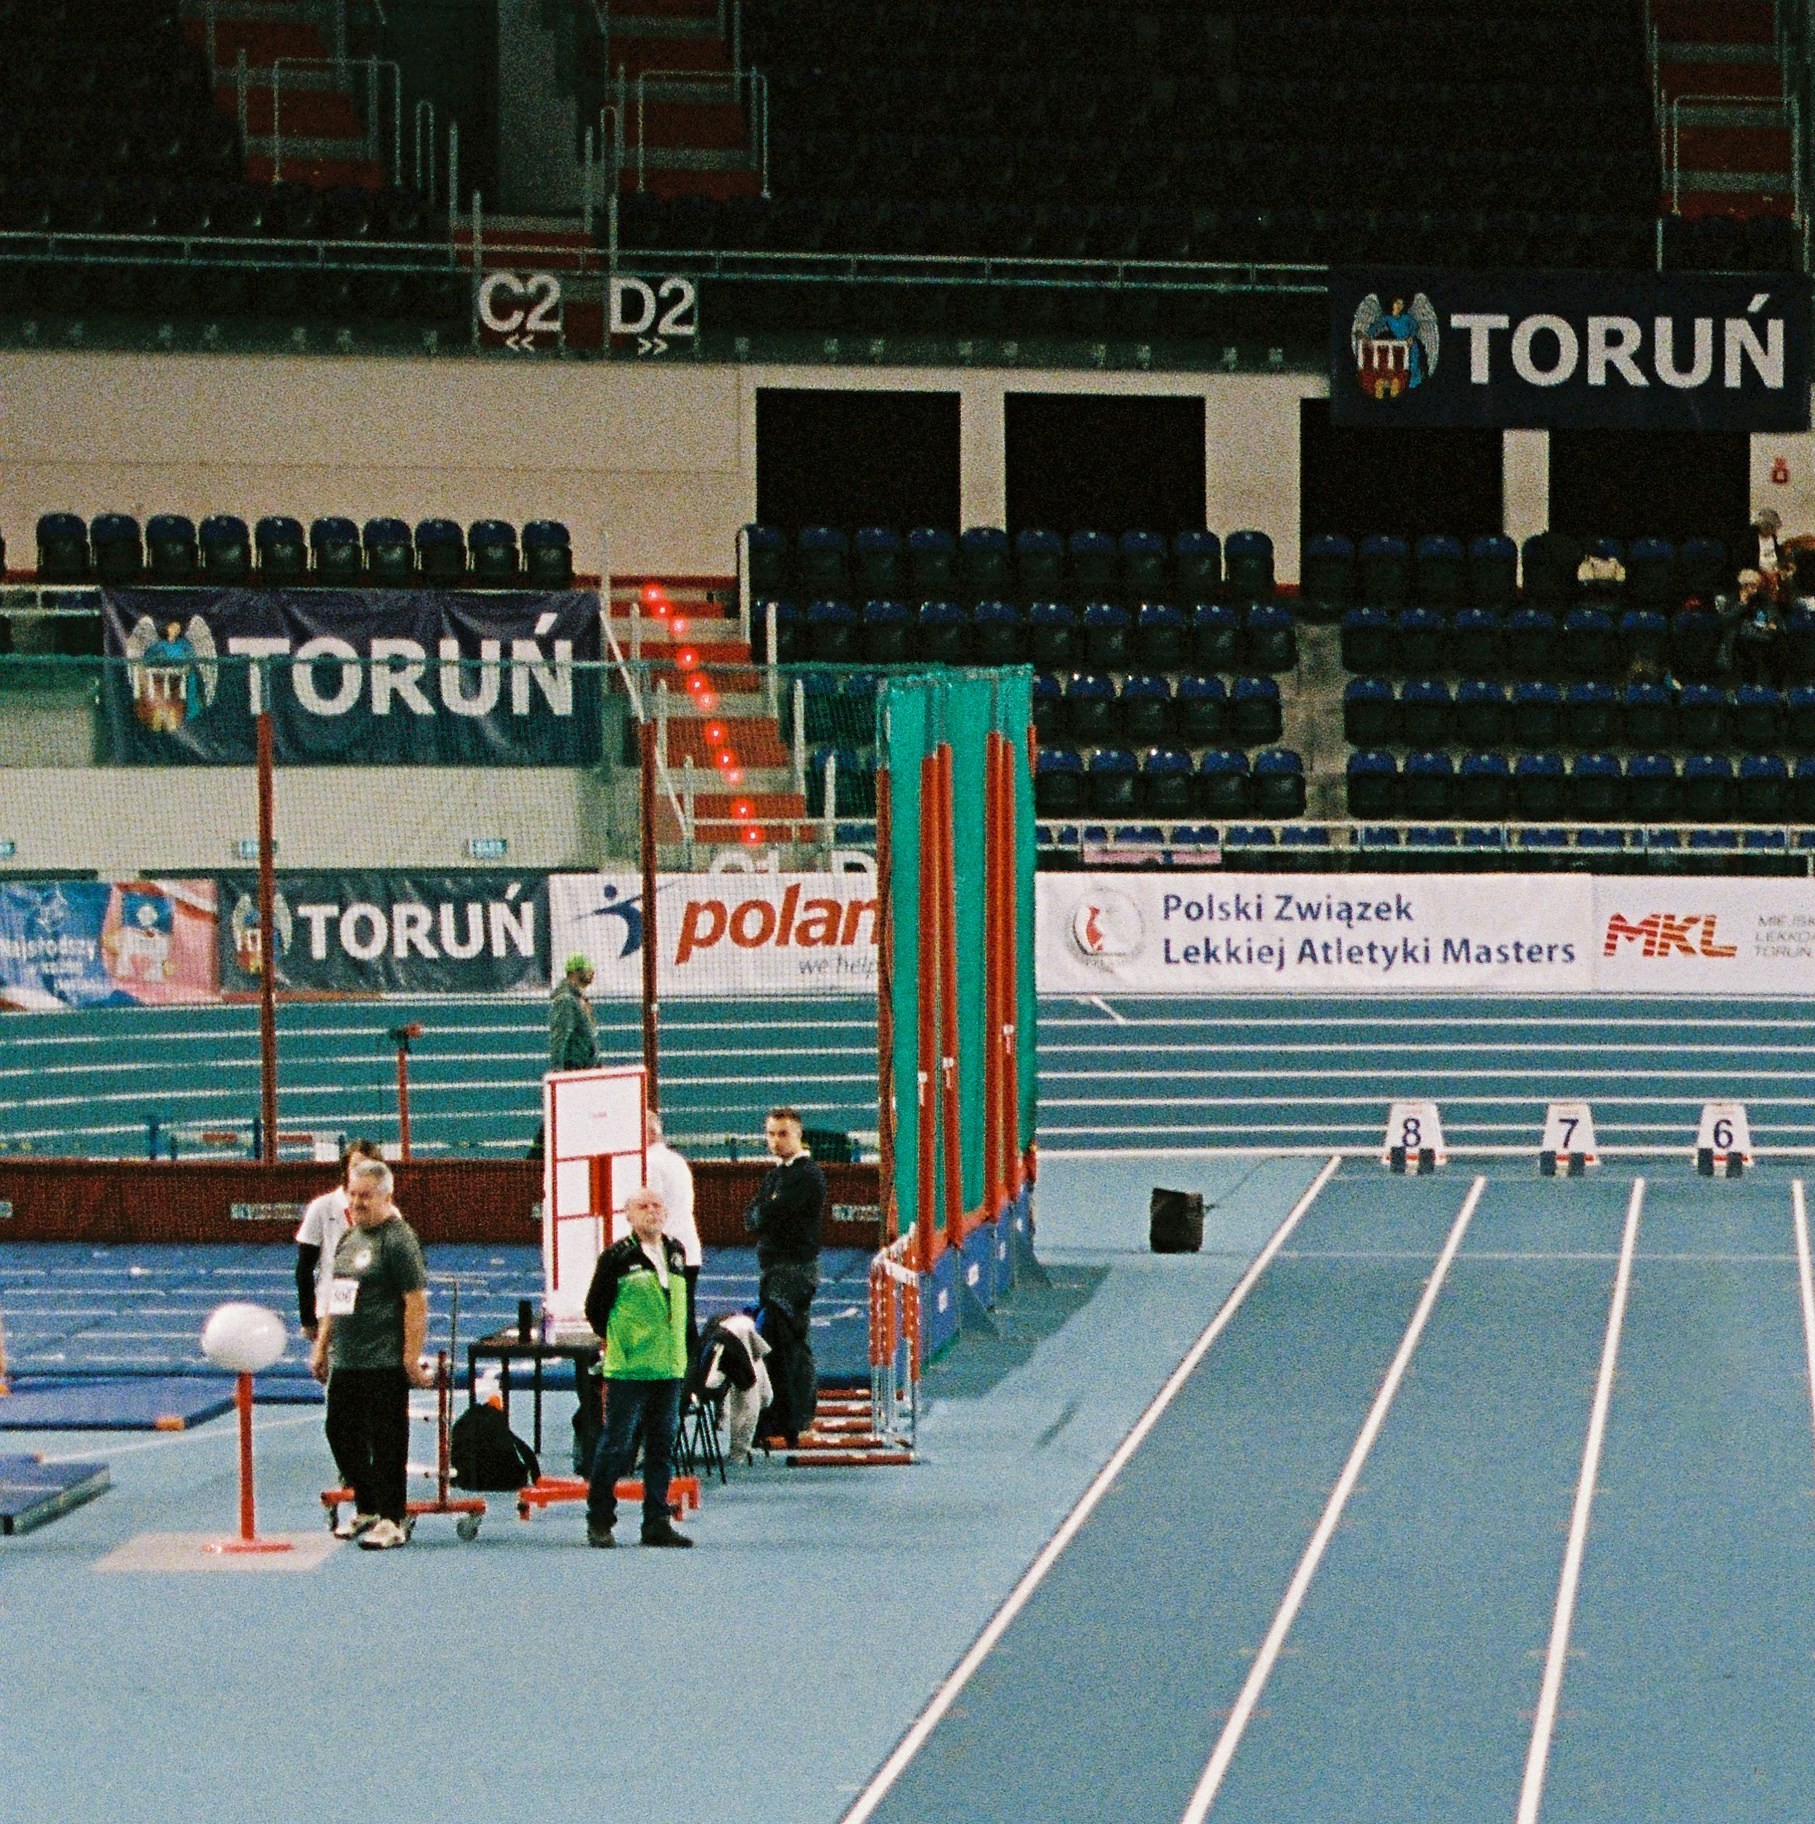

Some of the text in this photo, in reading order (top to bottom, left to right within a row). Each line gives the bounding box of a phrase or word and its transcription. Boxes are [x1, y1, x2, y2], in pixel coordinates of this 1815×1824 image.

[477, 273, 563, 334] C2
[611, 275, 697, 337] D2
[1451, 293, 1786, 390] TORUŃ
[228, 613, 574, 716] TORUŃ
[299, 884, 535, 961] TORUŃ
[675, 882, 880, 966] polan
[1163, 893, 1414, 928] Polski Związek
[1604, 912, 1738, 957] MKL
[1163, 937, 1576, 971] Lekkiej Atletyki Masters
[1401, 1116, 1422, 1148] 8
[1559, 1117, 1580, 1148] 7
[1712, 1117, 1735, 1149] 6
